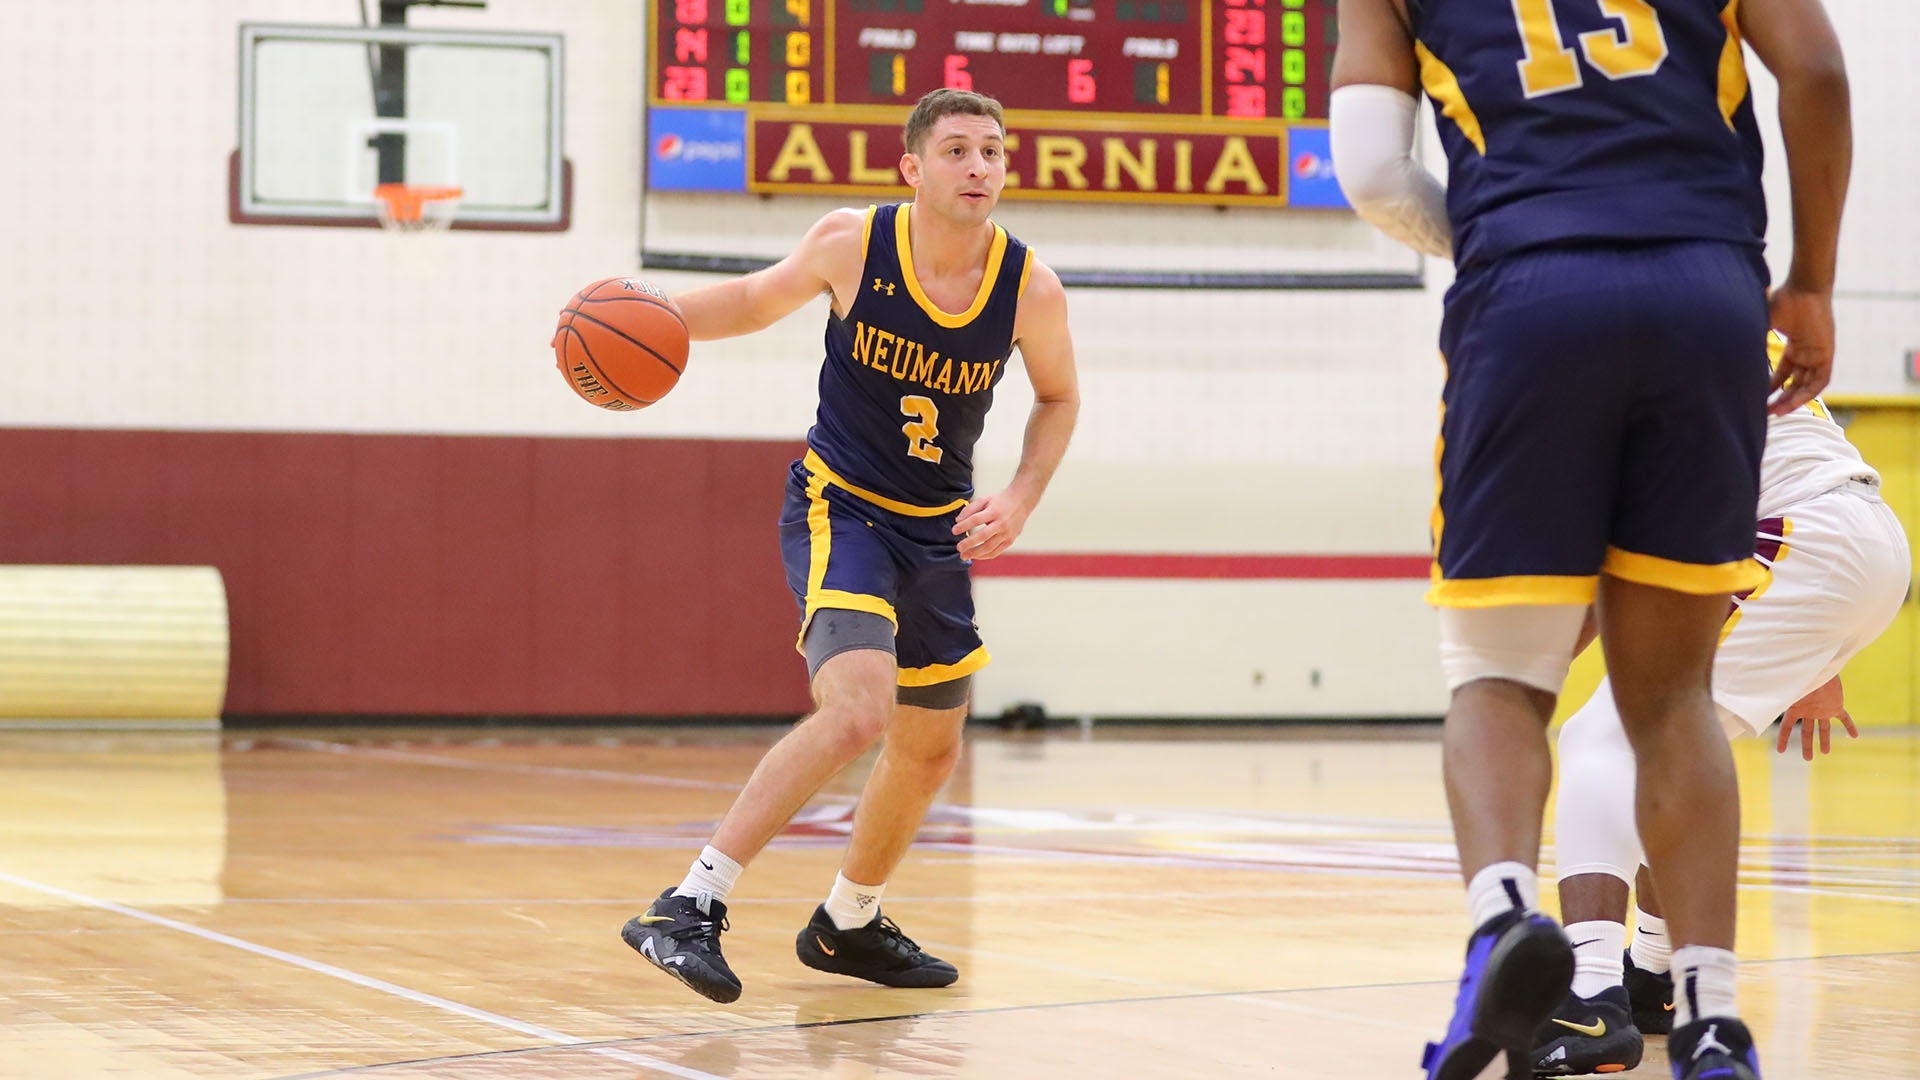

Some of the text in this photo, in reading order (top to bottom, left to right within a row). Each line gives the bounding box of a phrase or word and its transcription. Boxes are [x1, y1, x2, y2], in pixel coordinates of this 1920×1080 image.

[1067, 59, 1096, 103] 6
[1510, 0, 1669, 99] 13
[767, 122, 1267, 194] ALRNIA
[573, 362, 608, 398] THE
[852, 321, 1000, 394] NEUMANN
[900, 395, 943, 464] 2
